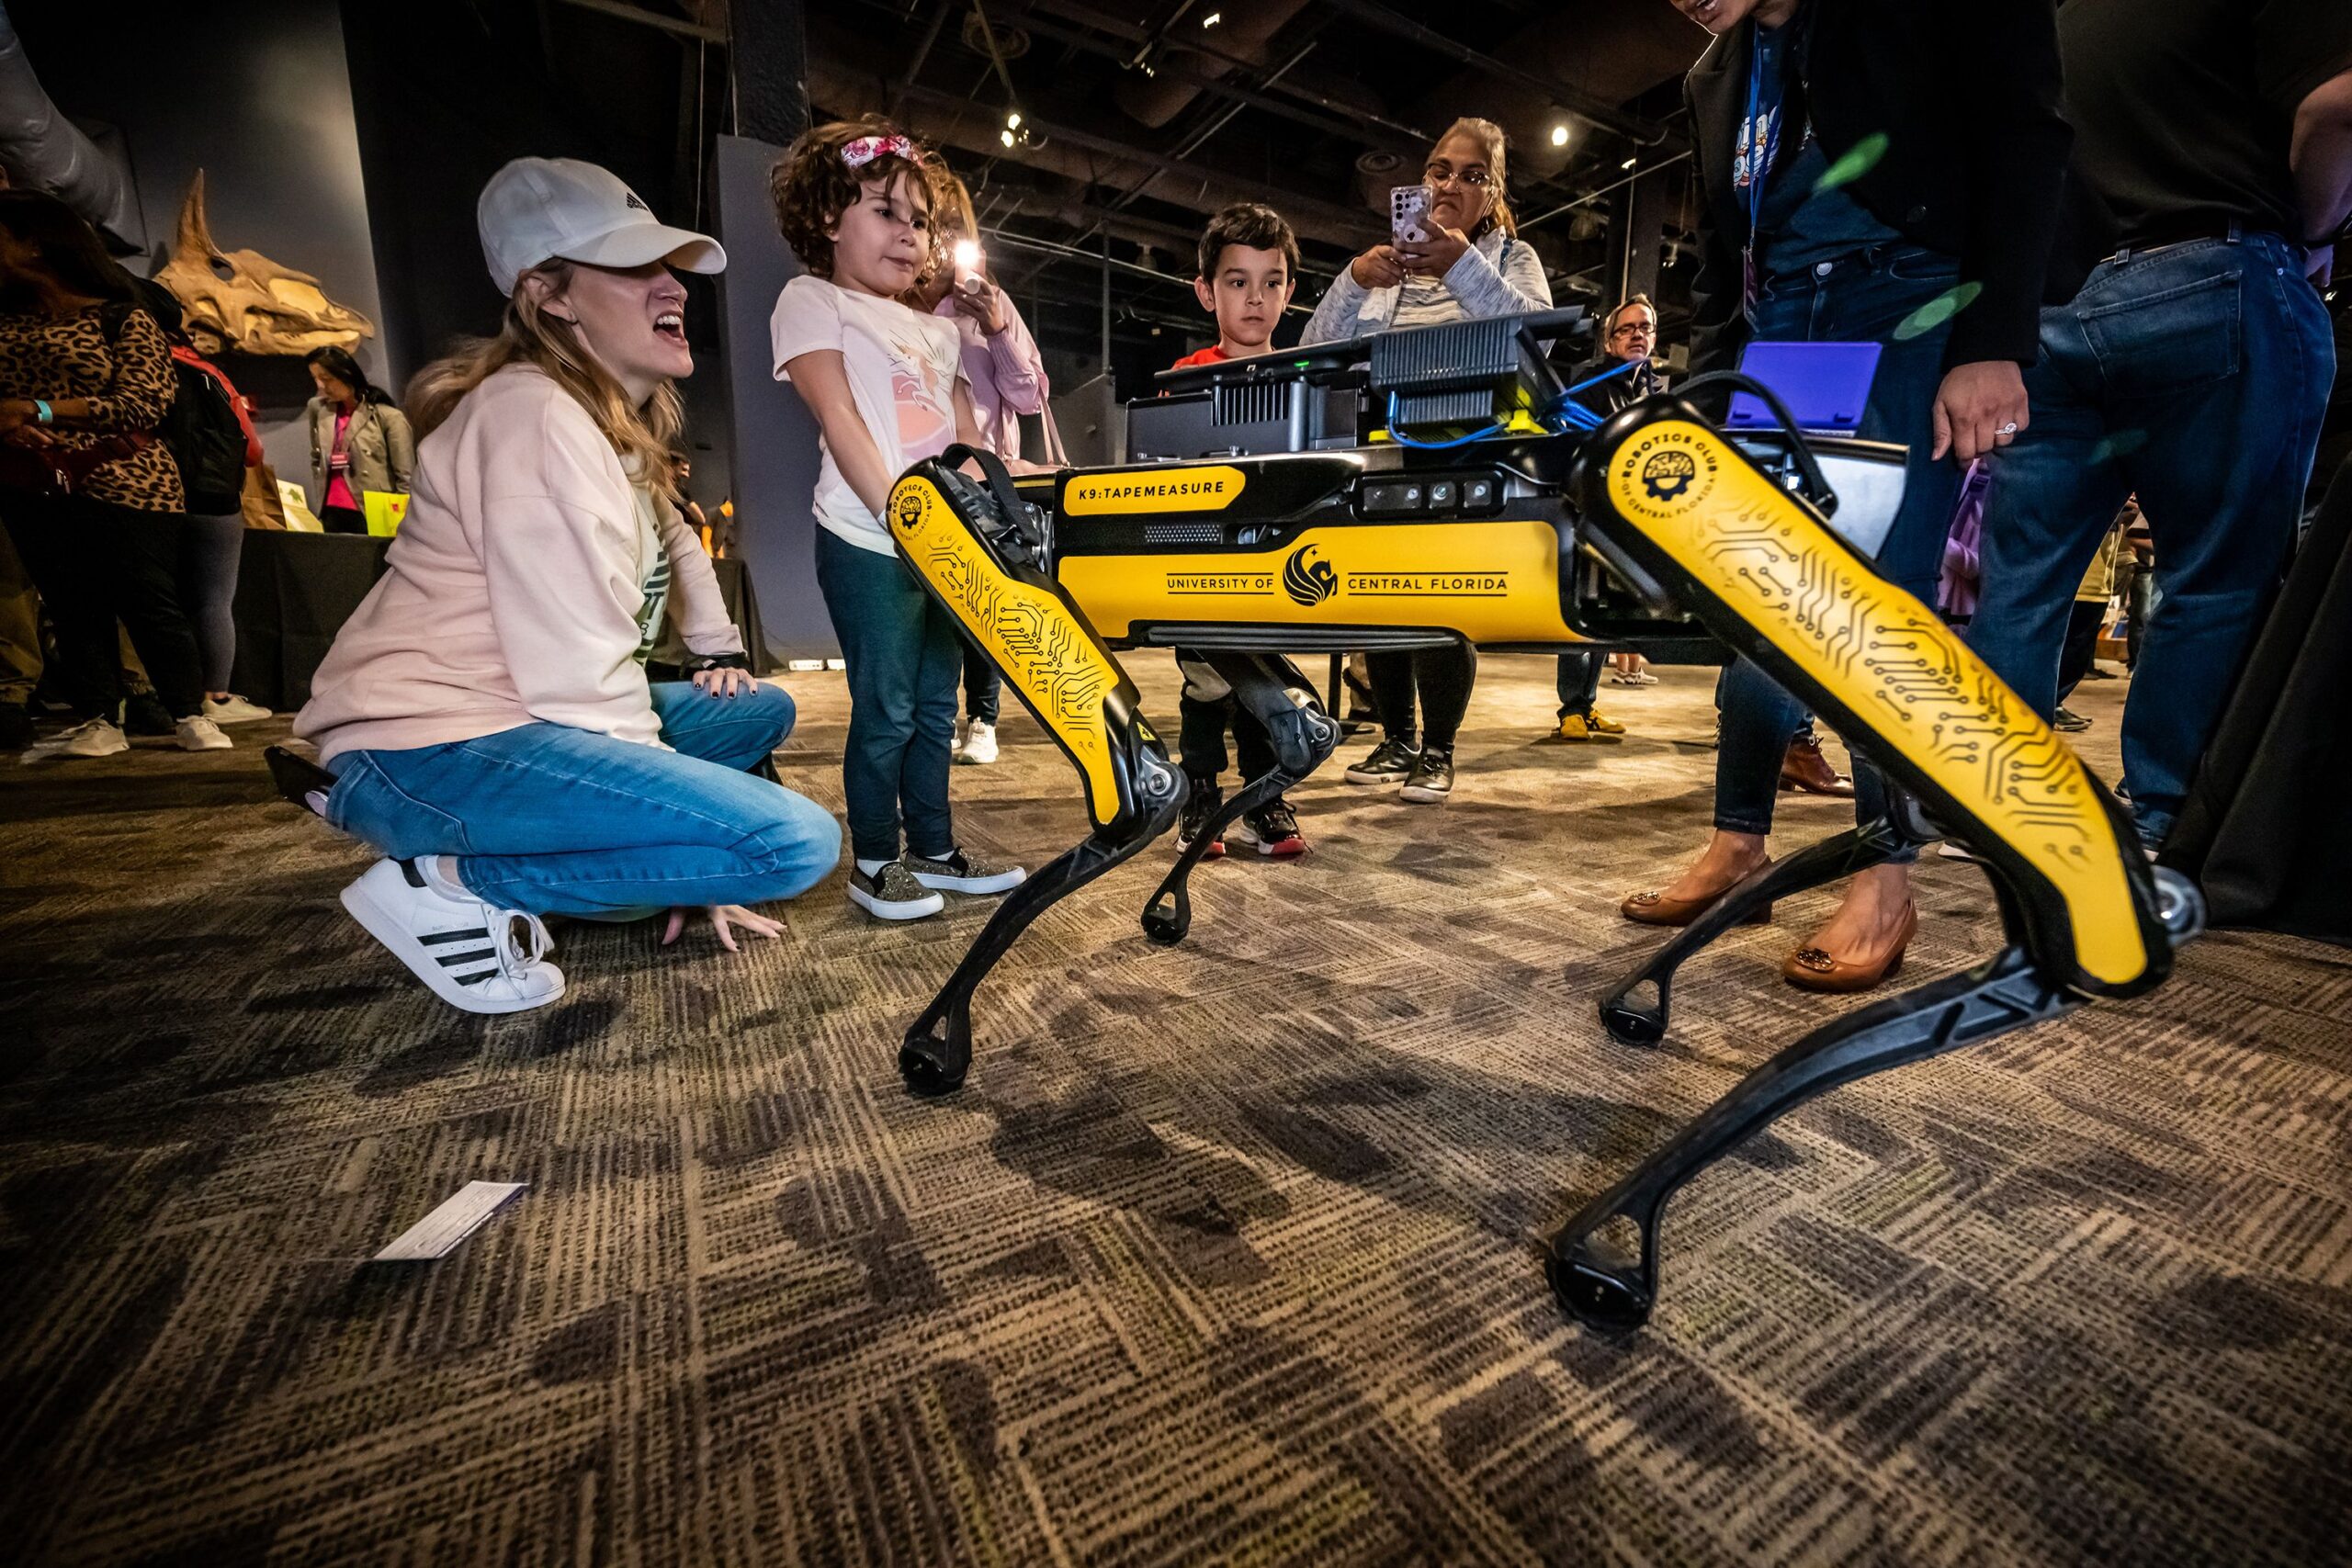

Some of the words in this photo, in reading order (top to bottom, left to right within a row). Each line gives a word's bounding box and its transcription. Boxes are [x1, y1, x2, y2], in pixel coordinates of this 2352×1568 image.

[1622, 434, 1691, 478] ROBOTICS
[1695, 442, 1717, 472] CLUB
[893, 484, 922, 513] ROBOTICS
[922, 490, 932, 510] CLUB
[1079, 481, 1224, 500] K9:TAPEMEASURE
[1628, 498, 1672, 518] CENTRAL
[1676, 479, 1714, 514] FLORIDA
[1168, 579, 1248, 589] UNIVERSITY
[1255, 579, 1273, 589] OF
[1348, 579, 1422, 590] CENTRAL
[1430, 579, 1508, 590] FLORIDA
